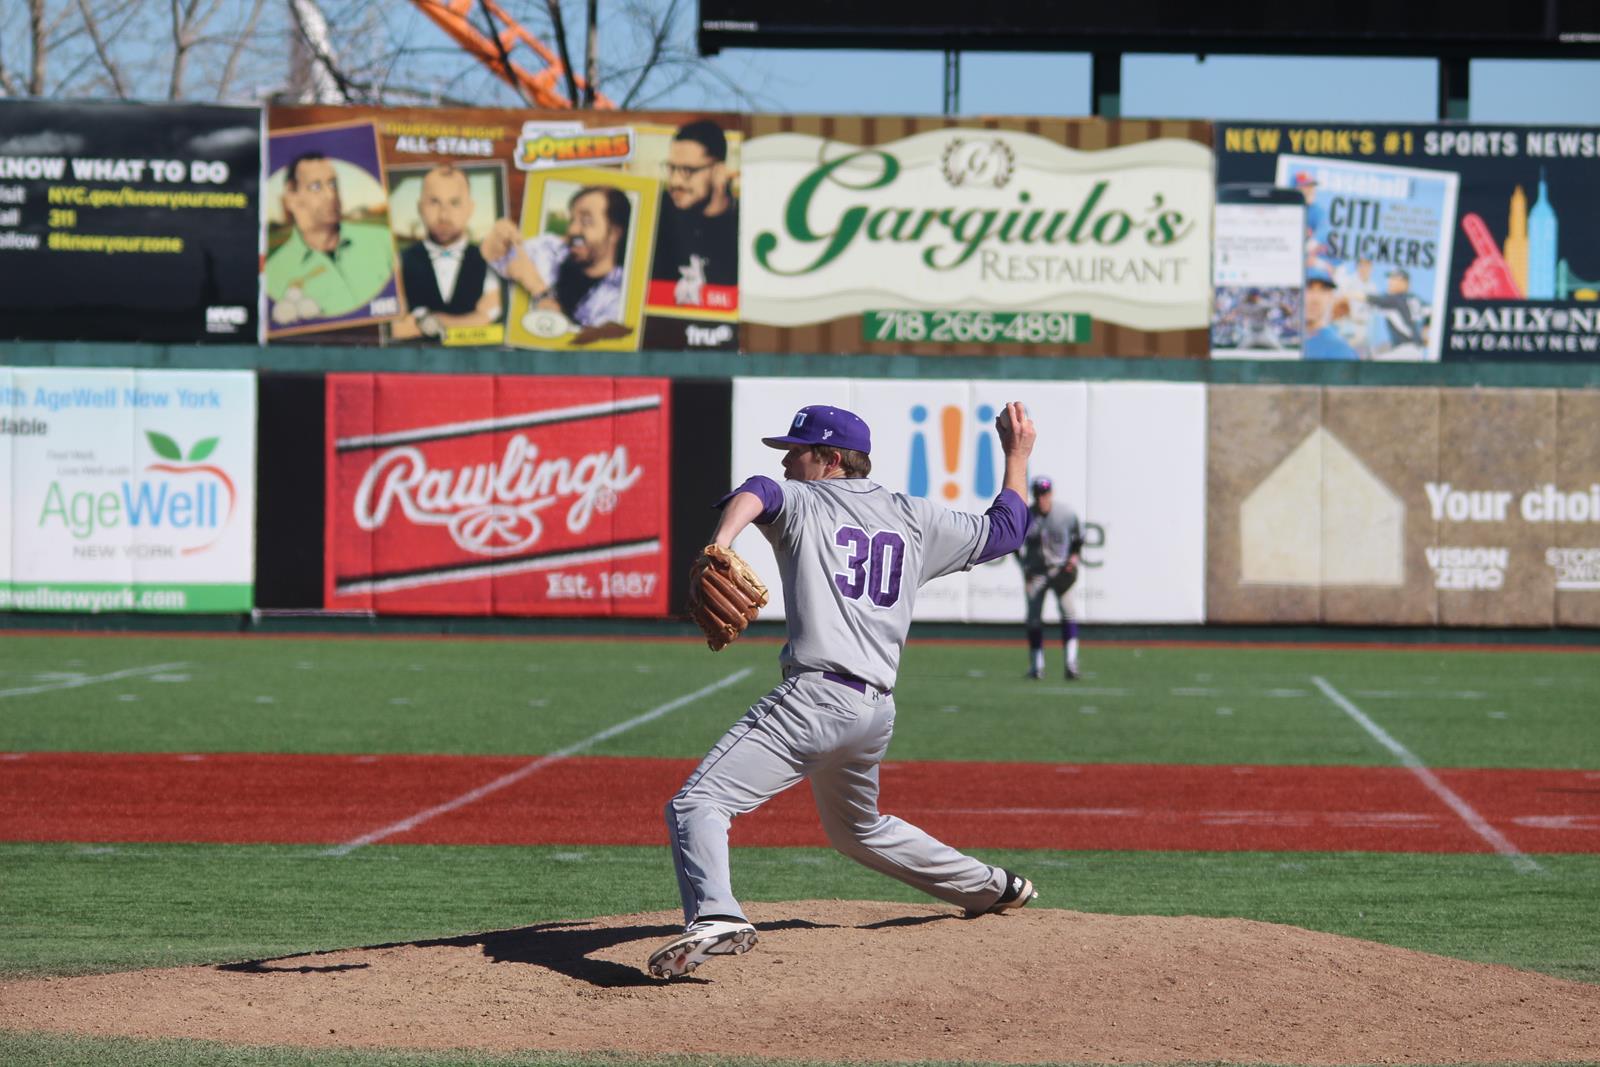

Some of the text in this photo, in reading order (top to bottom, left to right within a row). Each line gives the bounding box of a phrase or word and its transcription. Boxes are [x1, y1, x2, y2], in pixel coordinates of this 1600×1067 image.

[395, 136, 495, 157] ALL-STARS
[522, 134, 630, 164] JOKERS
[1225, 128, 1600, 158] NEW YORK'S #1 SPORTS NEWS
[73, 158, 146, 182] WHAT
[150, 161, 186, 183] TO
[191, 161, 229, 184] DO
[48, 209, 76, 228] 311
[752, 142, 1195, 277] Gargiulo's
[1329, 196, 1381, 231] CITI
[1326, 230, 1437, 269] SLICKERS
[979, 249, 1188, 284] RESTAURANT
[874, 311, 1077, 343] 718 266-4891
[1452, 306, 1553, 333] DAILY
[34, 387, 118, 412] AgeWell
[124, 388, 170, 408] New
[176, 388, 221, 409] York
[354, 433, 644, 533] Rawlings
[38, 480, 218, 540] AgeWell
[1424, 481, 1600, 523] Your choi
[72, 544, 176, 559] NEW YORK
[1424, 547, 1509, 570] VISION
[833, 524, 907, 610] 30
[1434, 568, 1505, 590] ZERO
[546, 573, 656, 599] Est. 1887
